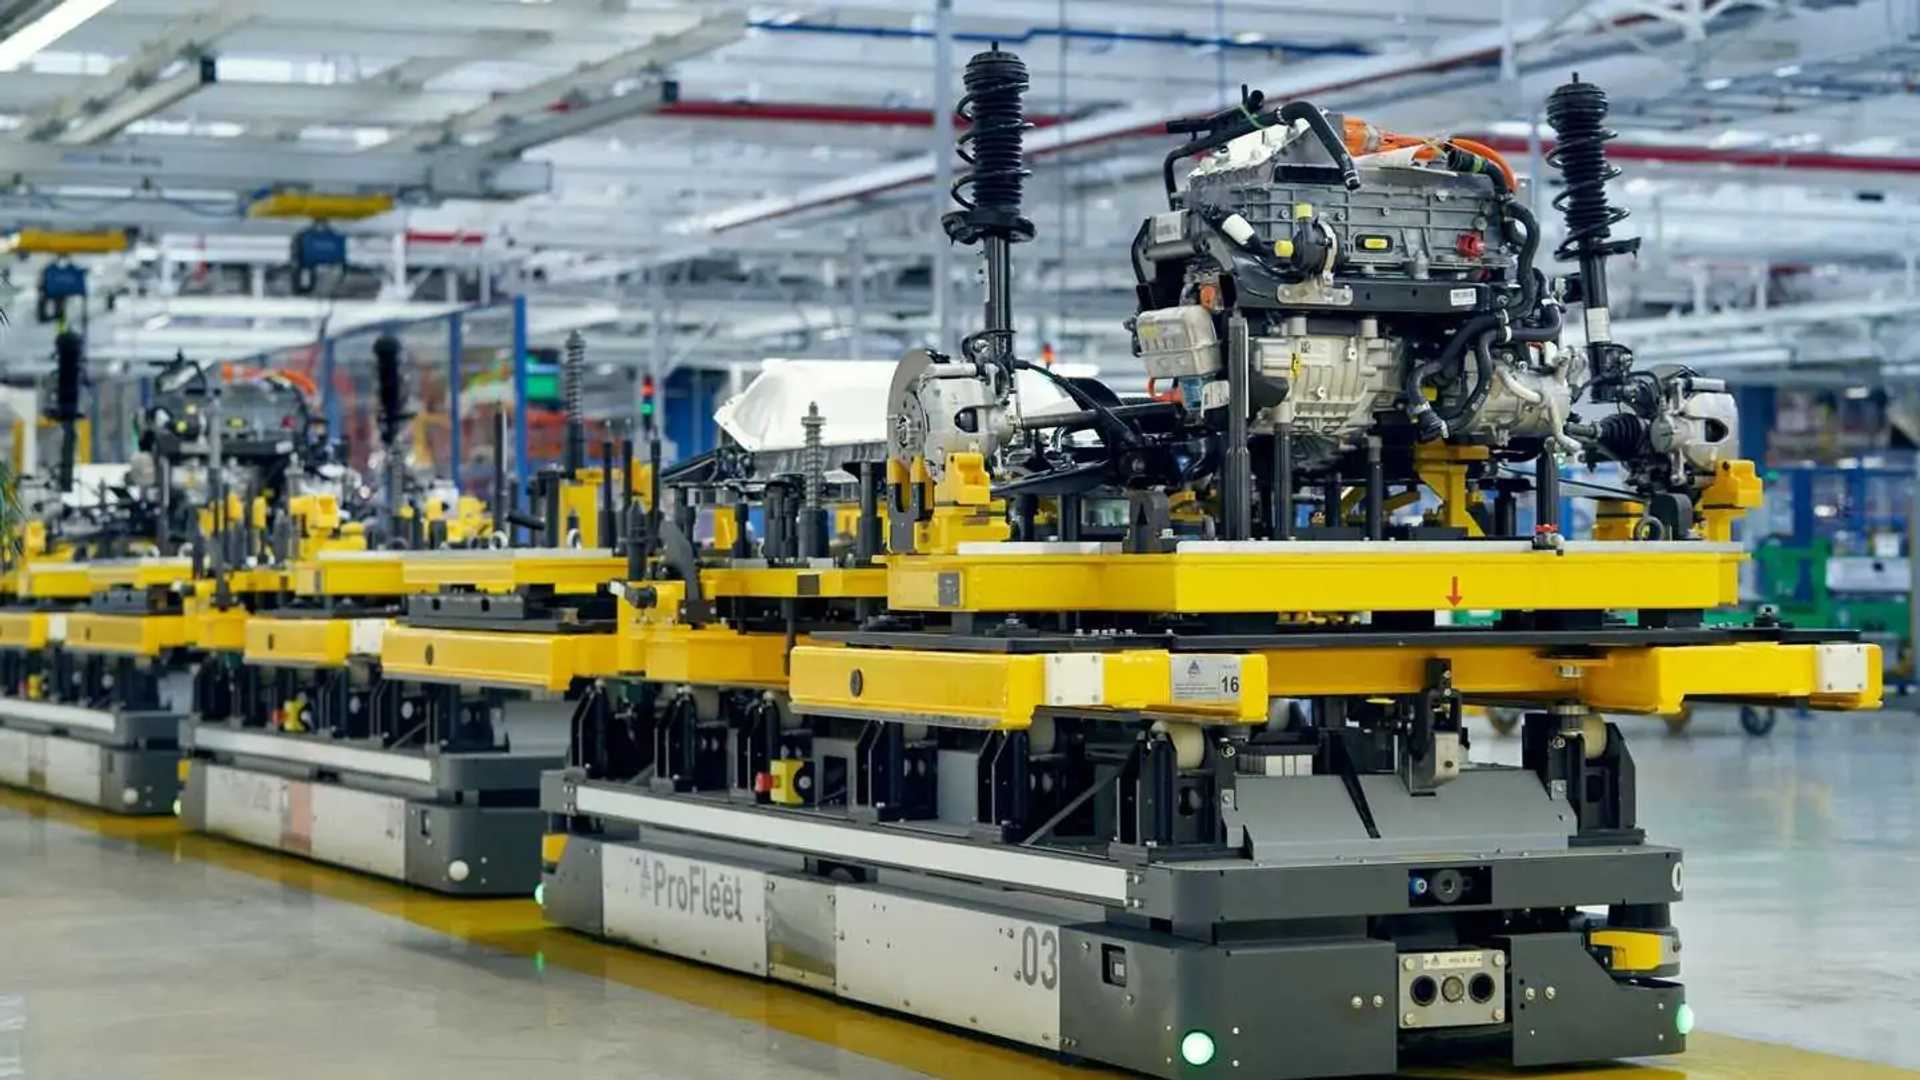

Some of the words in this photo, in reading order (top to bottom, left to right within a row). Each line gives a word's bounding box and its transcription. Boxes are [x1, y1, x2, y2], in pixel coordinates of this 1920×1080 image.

[1221, 675, 1240, 693] 16
[654, 860, 744, 923] ProFleet
[1022, 926, 1058, 991] 03
